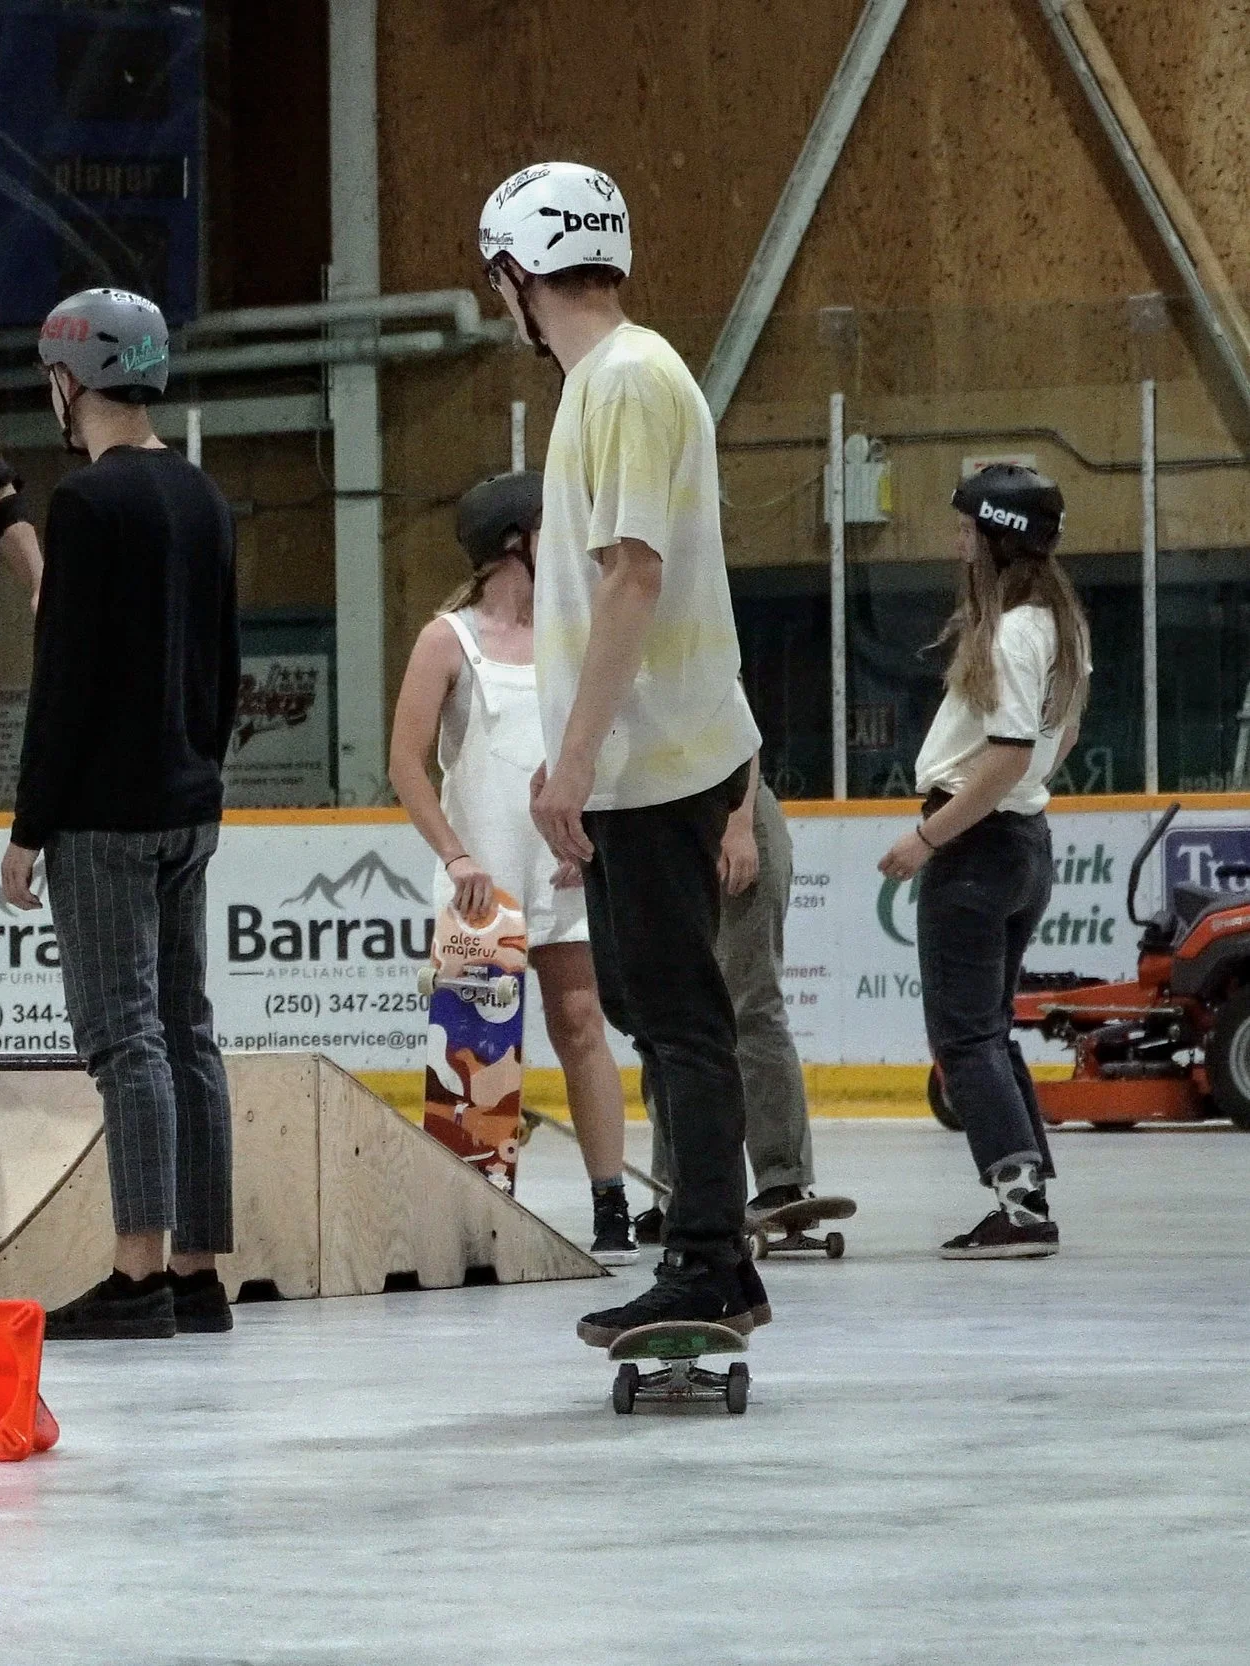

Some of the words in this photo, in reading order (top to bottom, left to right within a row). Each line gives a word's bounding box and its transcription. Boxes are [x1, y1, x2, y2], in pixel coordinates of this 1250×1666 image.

[562, 210, 625, 234] bern
[978, 500, 1029, 533] bern
[793, 873, 831, 887] roup
[1030, 904, 1116, 946] ctric
[450, 933, 481, 949] alec
[265, 966, 367, 979] APPLIANCE
[855, 974, 887, 999] All
[264, 993, 321, 1018] (250)
